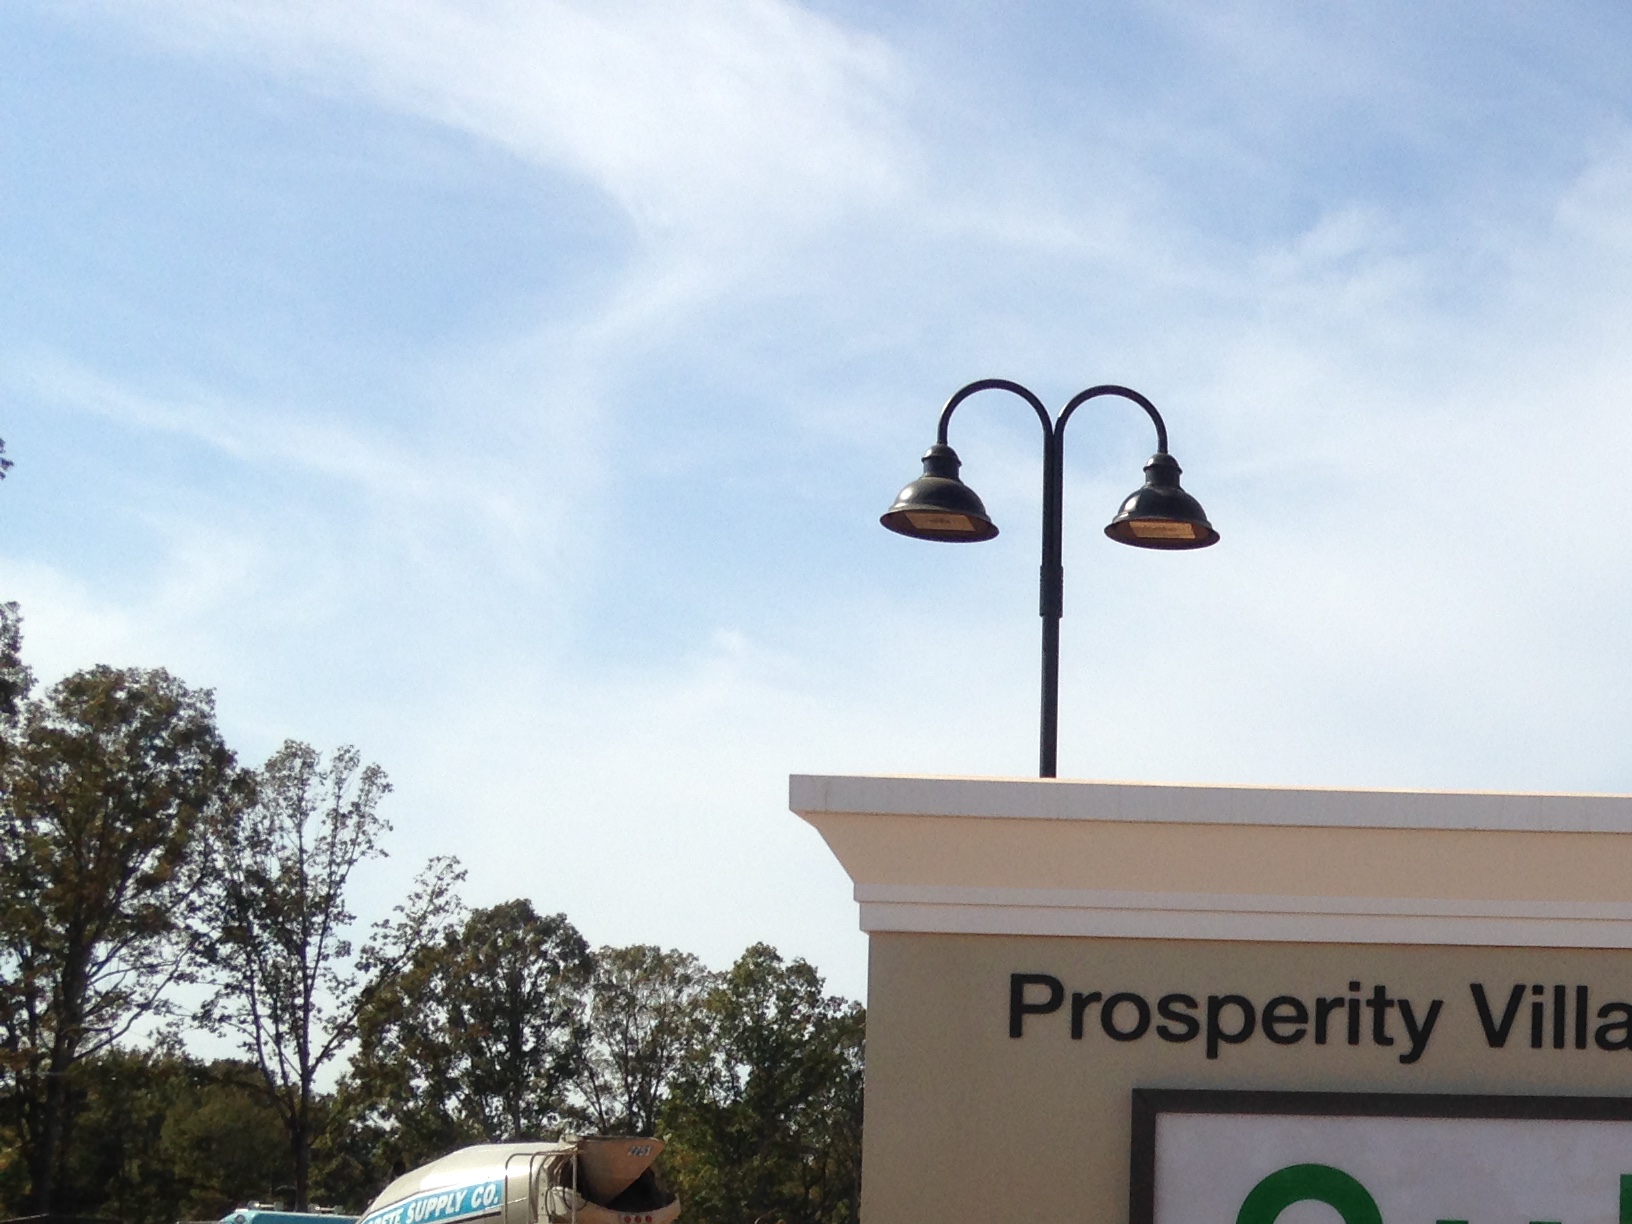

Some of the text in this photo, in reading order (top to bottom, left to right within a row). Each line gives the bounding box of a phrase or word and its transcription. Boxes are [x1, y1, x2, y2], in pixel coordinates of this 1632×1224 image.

[1008, 973, 1444, 1066] Prosperity
[405, 1189, 467, 1224] SUPPLY
[471, 1184, 498, 1208] CO.
